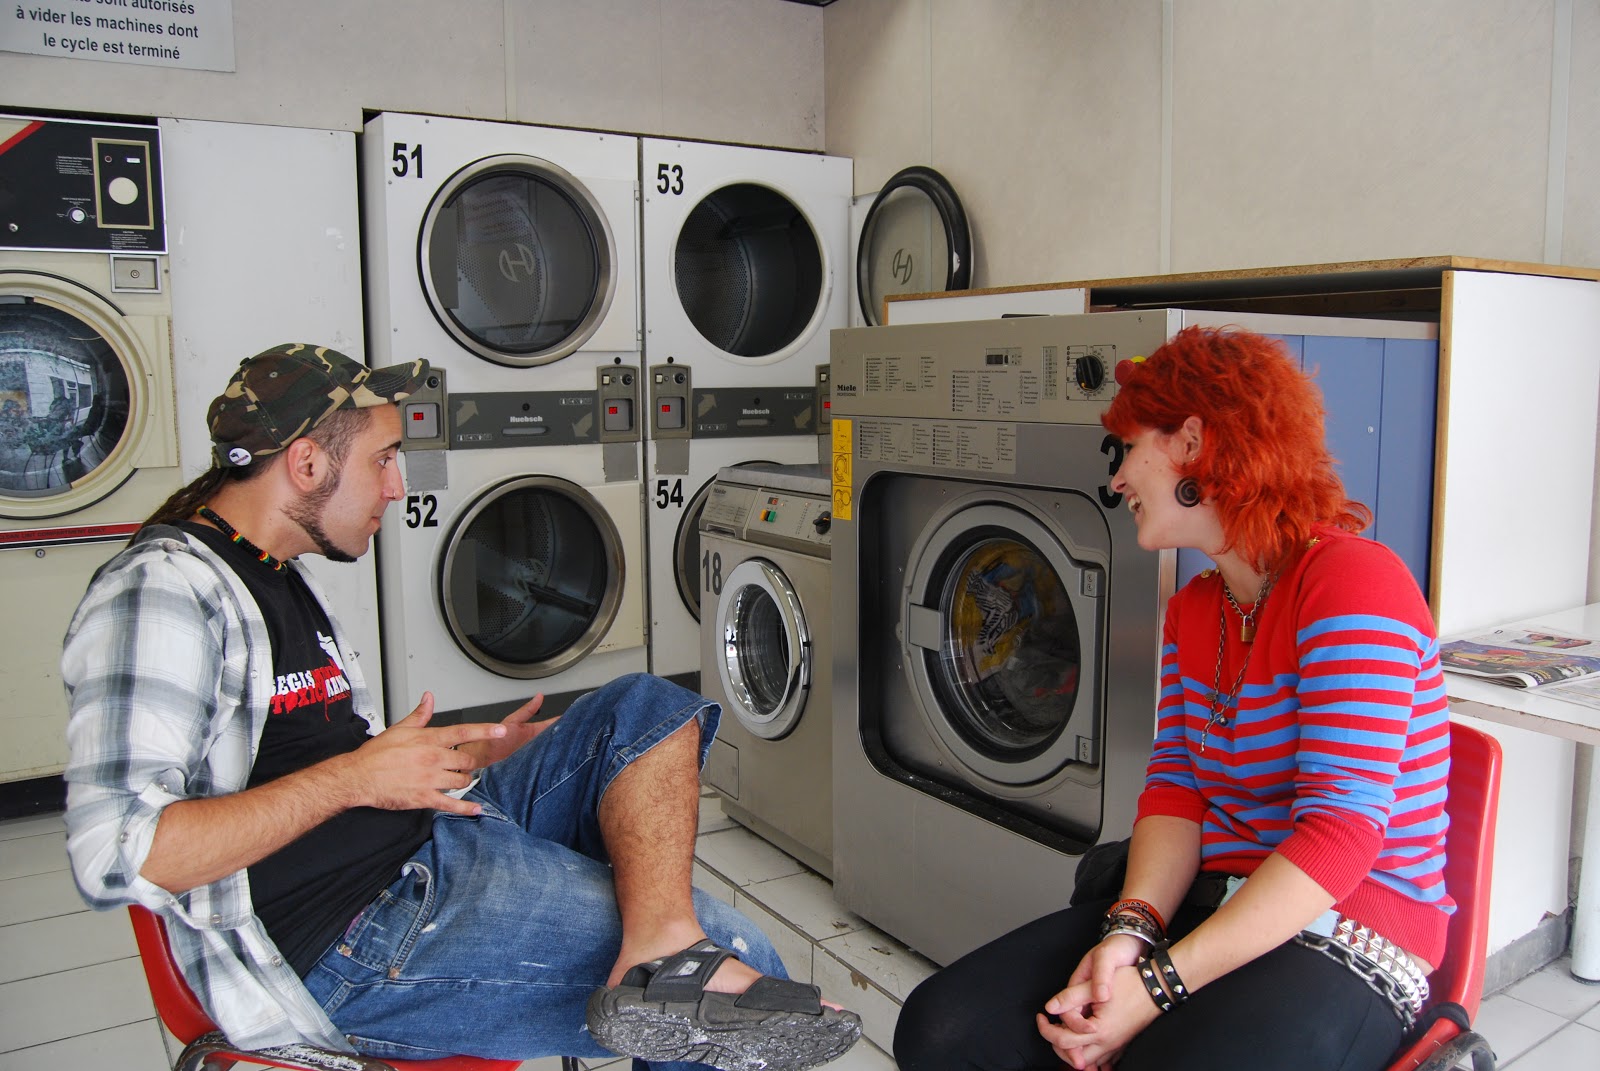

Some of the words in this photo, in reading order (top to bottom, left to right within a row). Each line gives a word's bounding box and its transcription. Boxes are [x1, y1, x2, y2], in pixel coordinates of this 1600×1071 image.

[16, 5, 25, 20] à
[29, 8, 66, 25] vider
[71, 12, 91, 27] les
[96, 16, 163, 35] machines
[168, 23, 199, 38] dont
[131, 0, 195, 14] autorisés
[43, 33, 56, 47] le
[61, 37, 98, 53] cycle
[103, 41, 124, 54] est
[128, 43, 180, 60] terminé
[392, 142, 423, 178] 51
[656, 163, 684, 195] 53
[509, 415, 543, 423] Huebsch
[656, 479, 684, 509] 54
[405, 495, 438, 529] 52
[702, 549, 722, 596] 18
